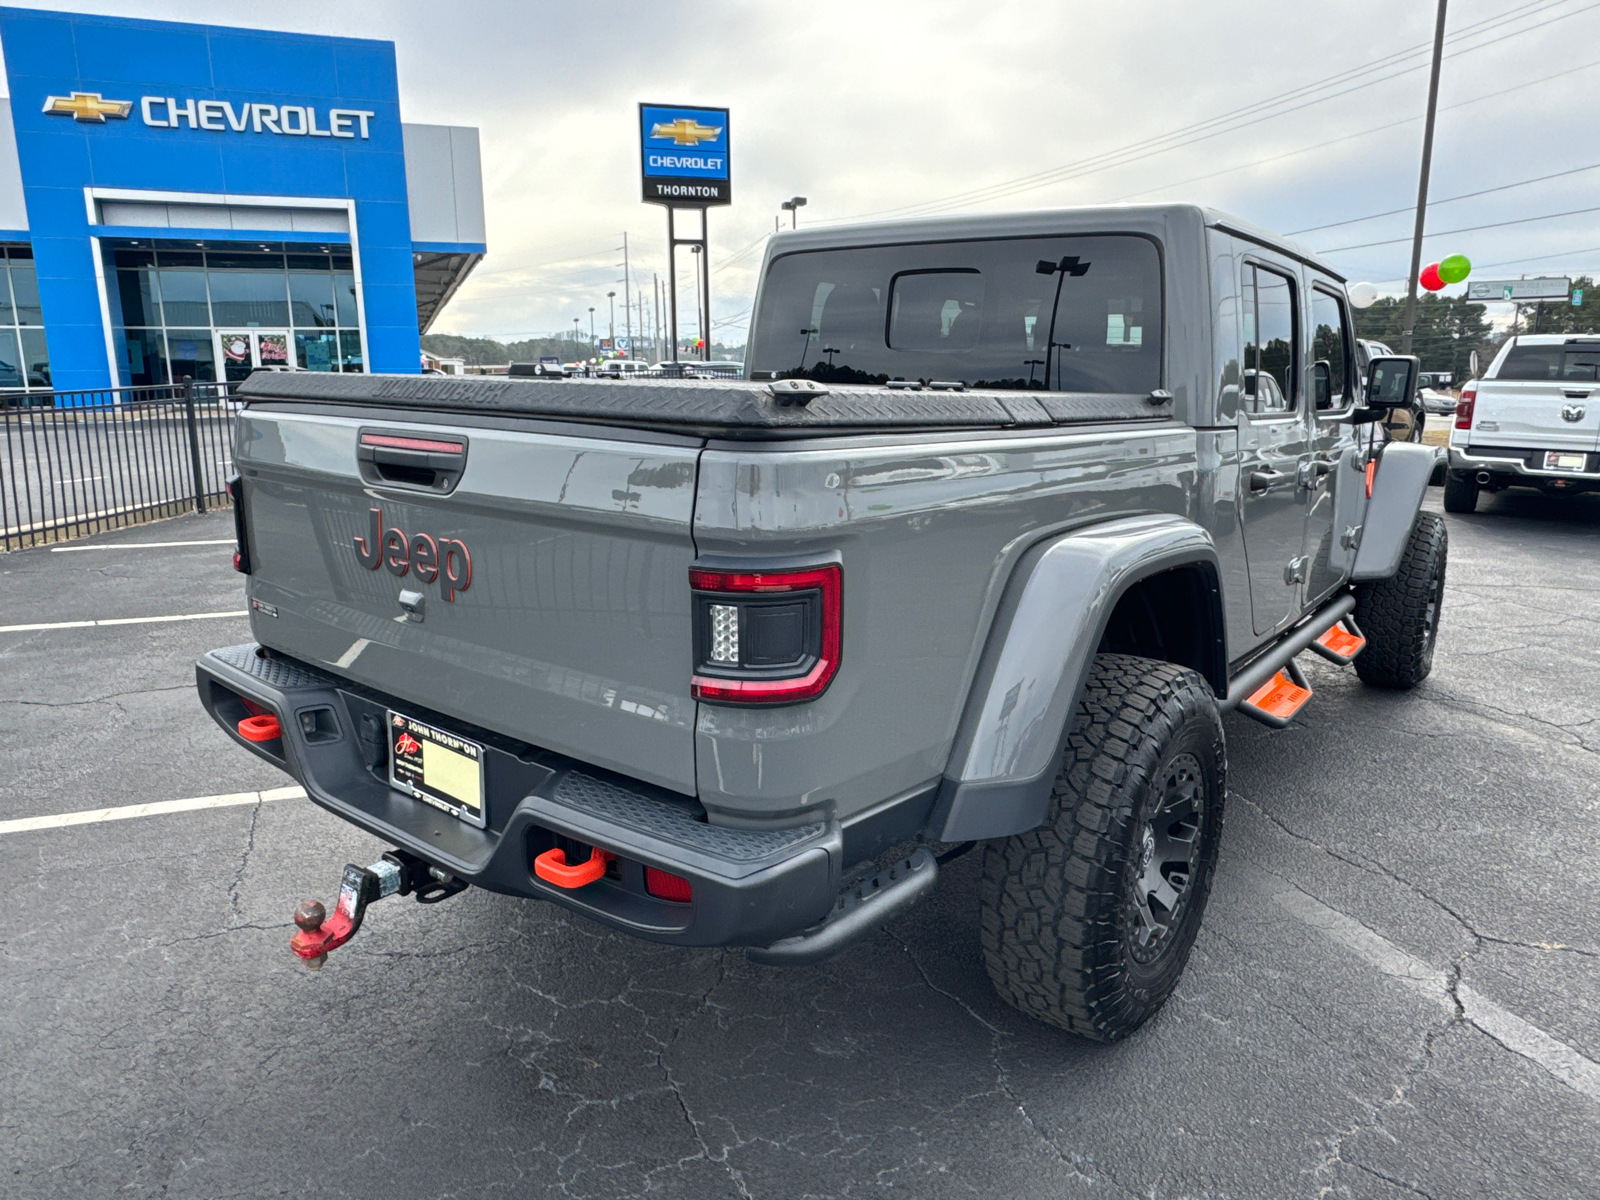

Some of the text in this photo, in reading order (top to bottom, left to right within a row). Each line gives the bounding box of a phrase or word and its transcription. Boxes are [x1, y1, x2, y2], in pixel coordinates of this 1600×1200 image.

[140, 95, 375, 139] CHEVROLET
[649, 155, 723, 170] CHEVROLET
[656, 184, 719, 197] THORNTON
[372, 378, 513, 404] DIAMONDBACK
[353, 508, 472, 602] Jeep
[408, 721, 430, 737] JOHN
[422, 794, 450, 813] CHEVROLET
